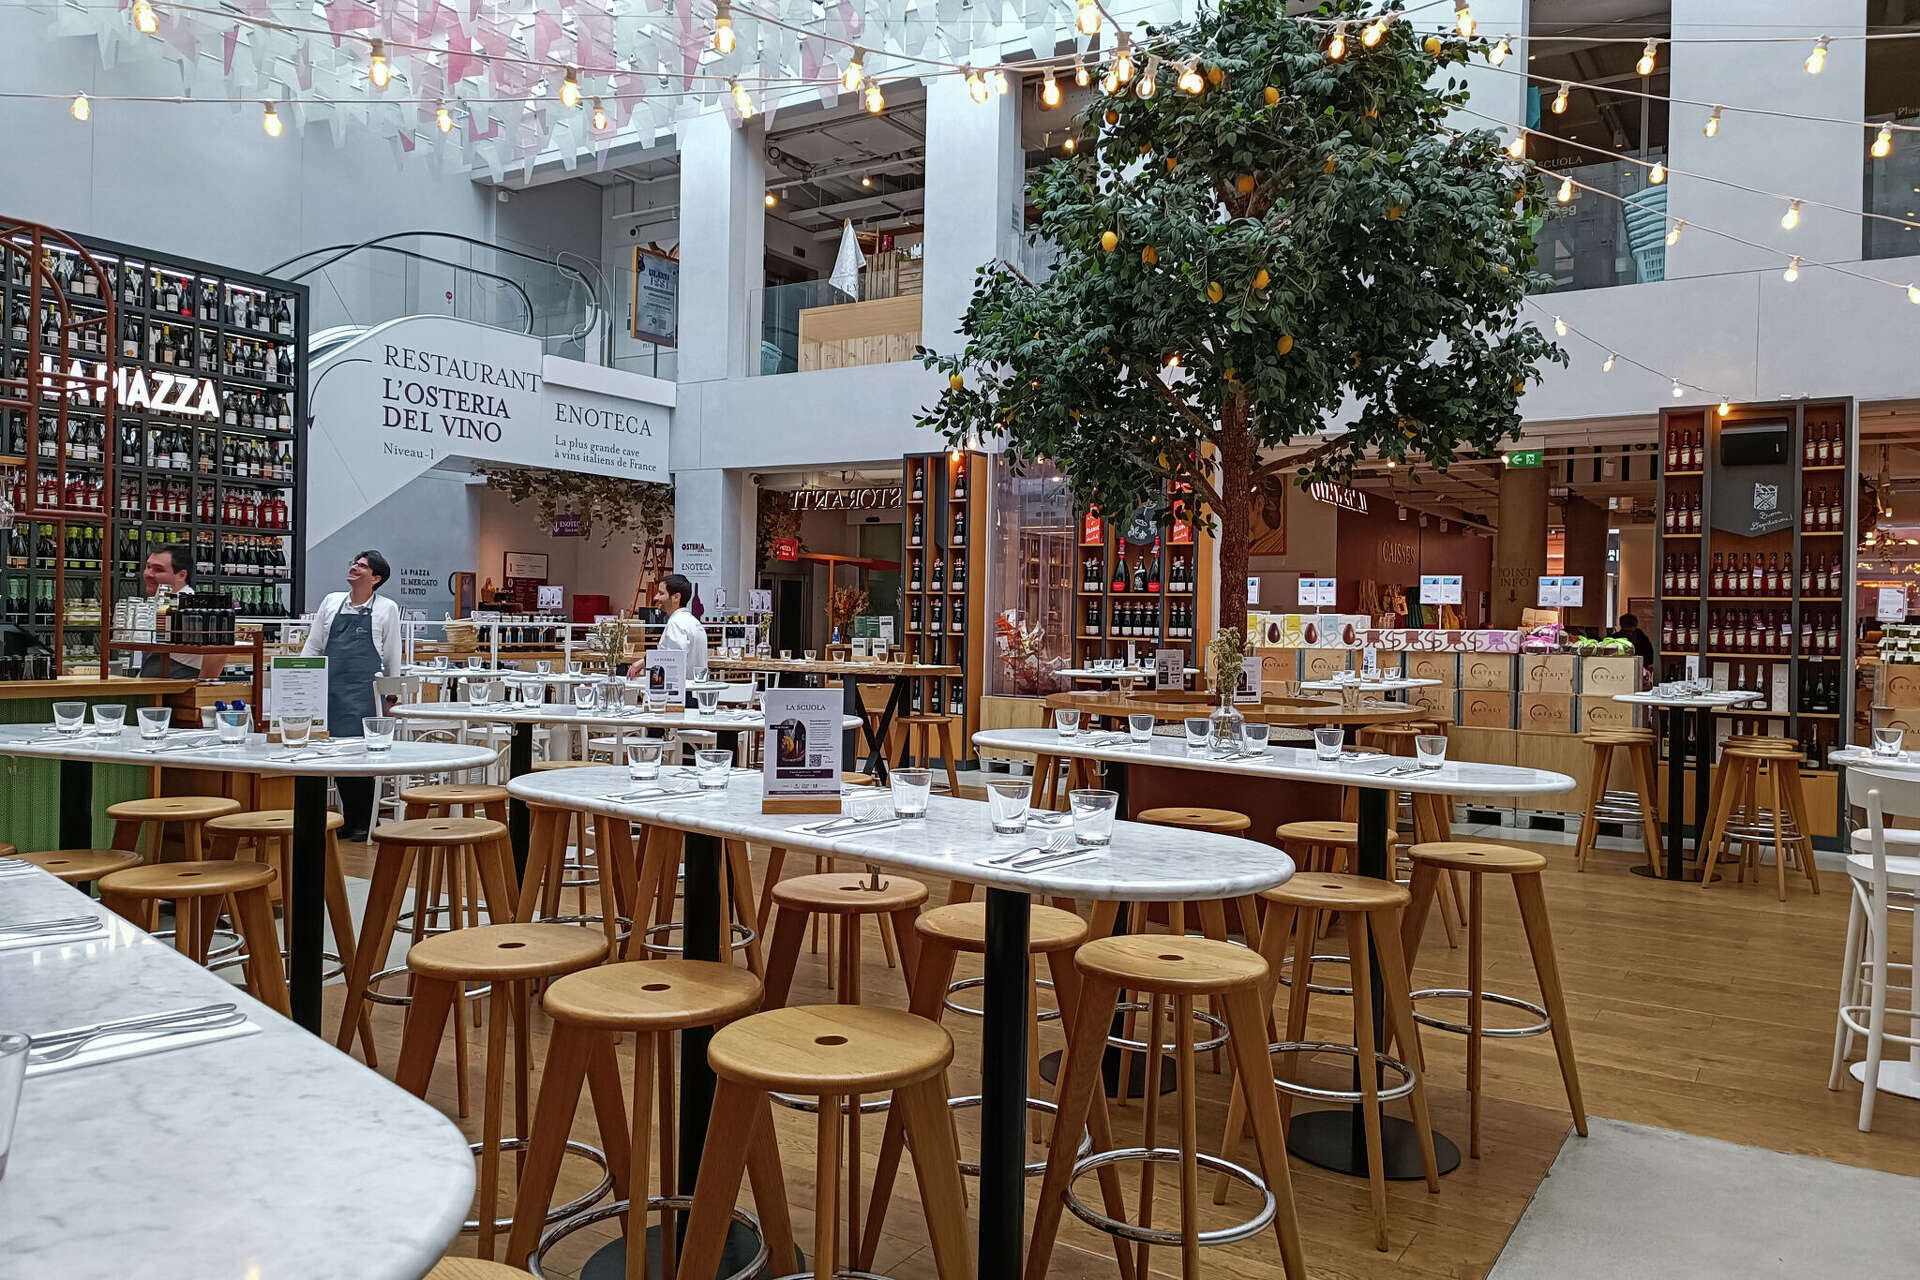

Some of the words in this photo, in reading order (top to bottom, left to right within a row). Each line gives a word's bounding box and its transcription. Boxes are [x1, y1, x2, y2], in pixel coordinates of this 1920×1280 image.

[384, 344, 543, 392] RESTAURANT
[43, 356, 89, 401] LA
[96, 364, 220, 417] PIAZZA
[382, 405, 433, 433] DEL
[440, 414, 502, 443] VINO
[555, 402, 653, 437] ENOTECA
[555, 435, 566, 447] La
[568, 437, 588, 452] plus
[589, 441, 621, 456] grande
[622, 448, 640, 457] cave
[554, 449, 560, 458] à
[562, 451, 581, 462] vins
[582, 453, 615, 467] italiens
[617, 457, 627, 468] de
[629, 460, 657, 473] France
[681, 543, 705, 551] OSTERIA
[1382, 540, 1416, 565] CAISSES
[400, 568, 408, 576] LA
[681, 561, 713, 571] ENOTECA
[400, 587, 407, 595] IL
[408, 587, 427, 596] PATIO
[408, 578, 438, 586] MERCATO
